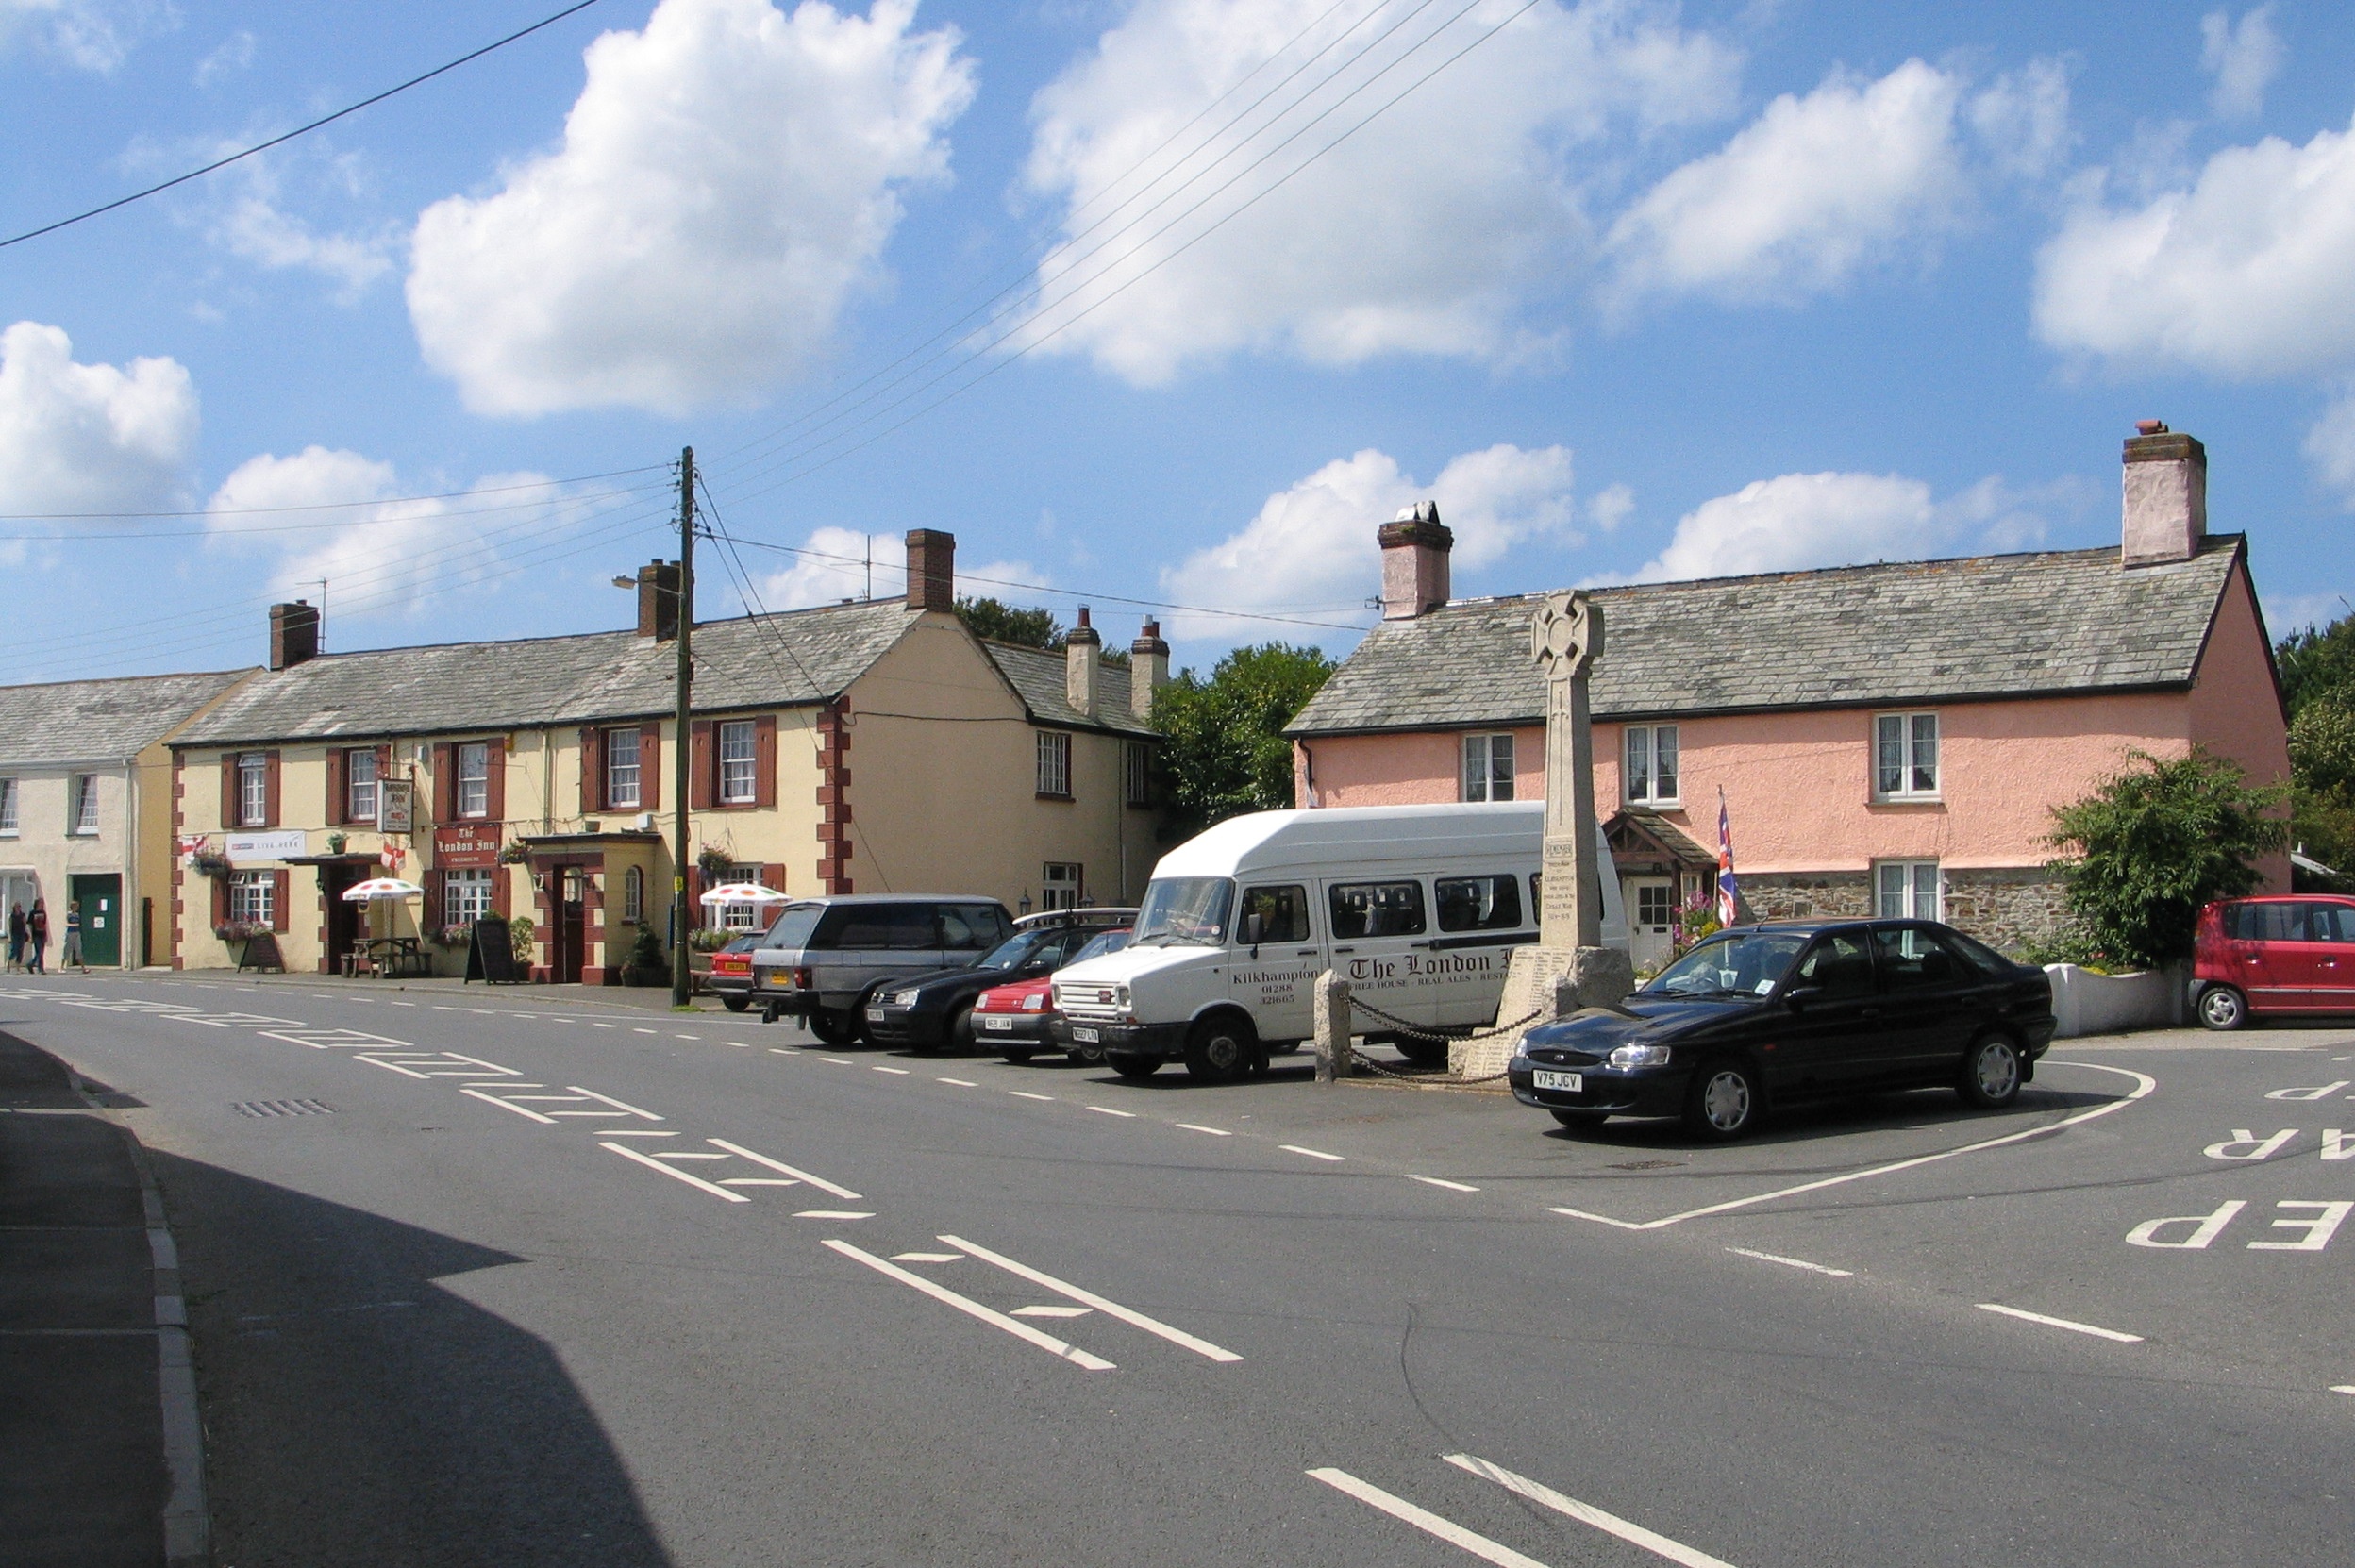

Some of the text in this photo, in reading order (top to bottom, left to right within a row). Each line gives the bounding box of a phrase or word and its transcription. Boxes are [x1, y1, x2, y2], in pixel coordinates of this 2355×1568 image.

[458, 828, 474, 839] The
[437, 839, 495, 853] London Inn
[1349, 959, 1395, 980] The
[1403, 953, 1491, 977] London
[1233, 969, 1319, 985] Kilkhampton
[1349, 981, 1374, 992] FREE
[1378, 979, 1407, 990] HOUSE
[1417, 976, 1443, 986] REAL
[1448, 975, 1472, 983] ALES
[1261, 984, 1294, 994] 01288
[1259, 994, 1295, 1006] 321605
[1537, 1072, 1556, 1087] V75
